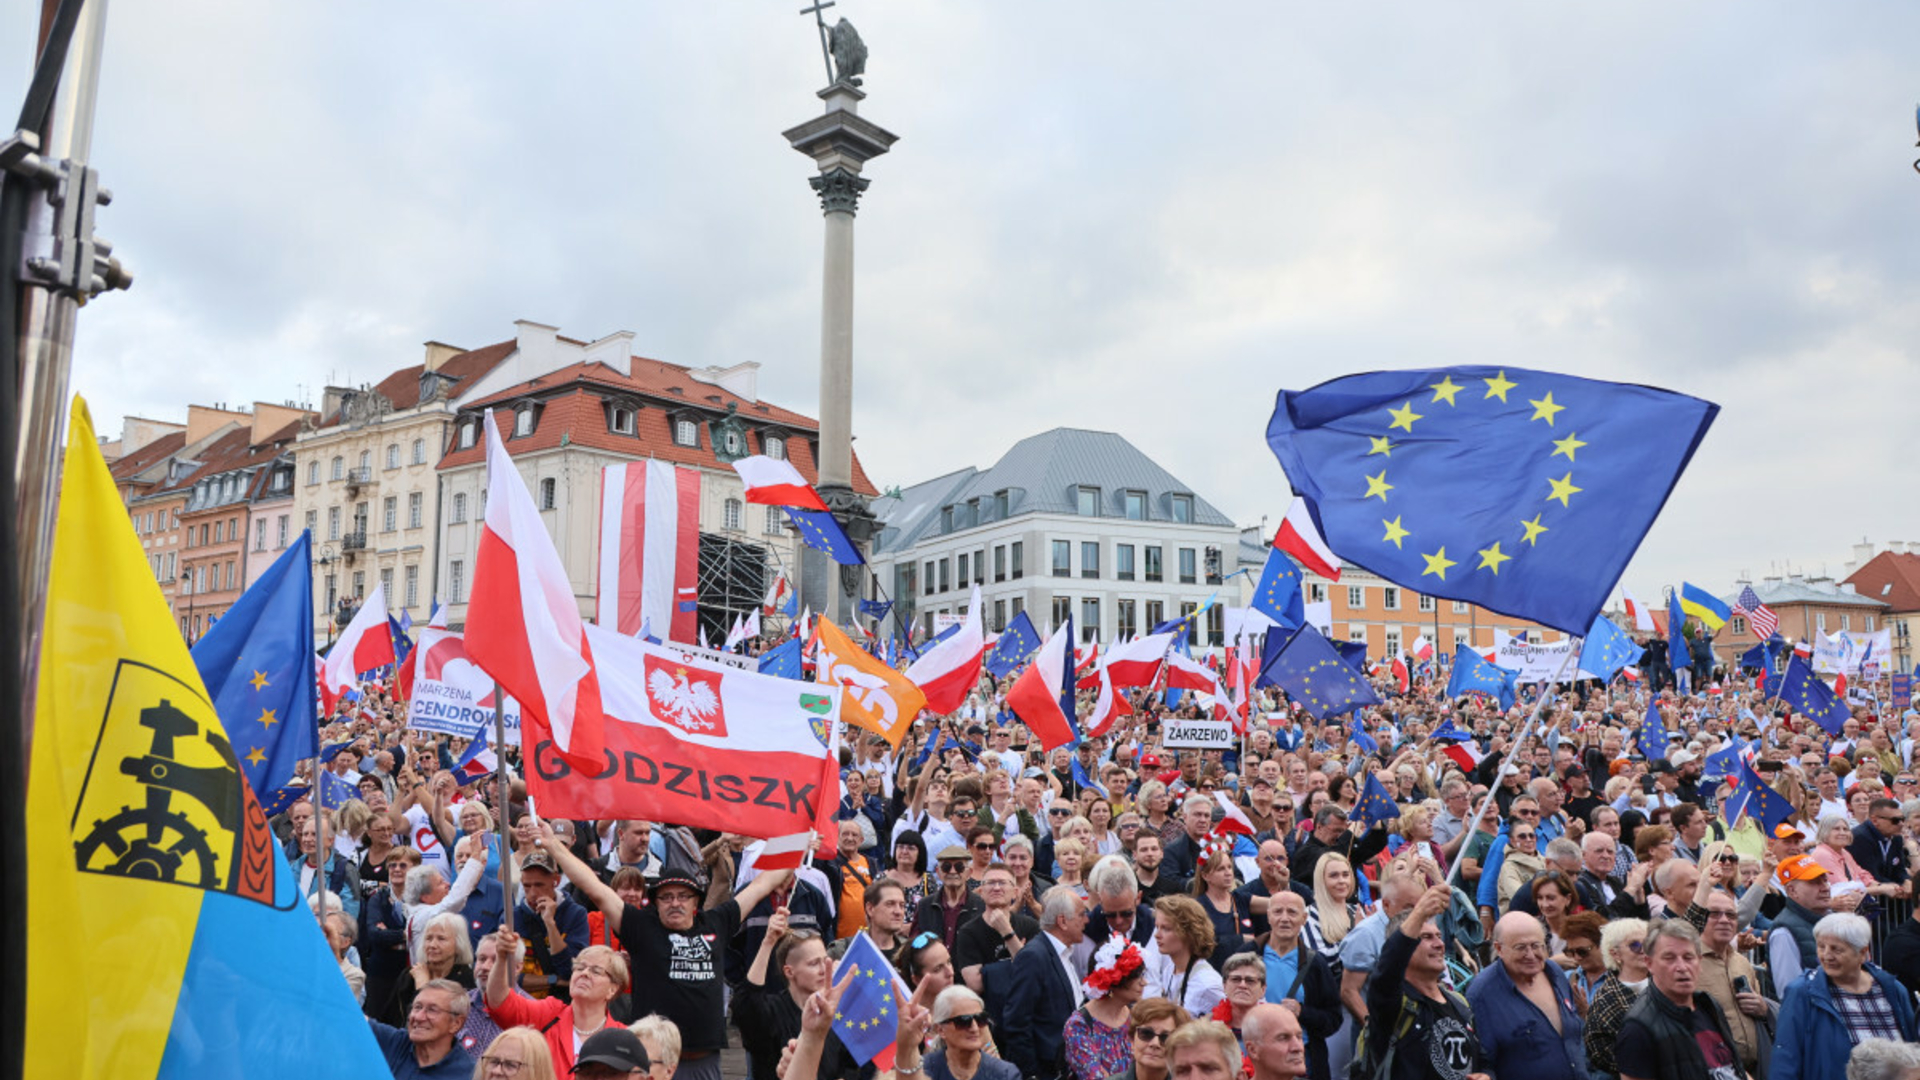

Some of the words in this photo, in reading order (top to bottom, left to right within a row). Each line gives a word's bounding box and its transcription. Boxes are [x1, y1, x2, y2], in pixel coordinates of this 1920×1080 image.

[417, 682, 473, 701] MARZENA
[1168, 726, 1228, 742] ZAKRZEWO
[534, 739, 838, 824] GODZISZK
